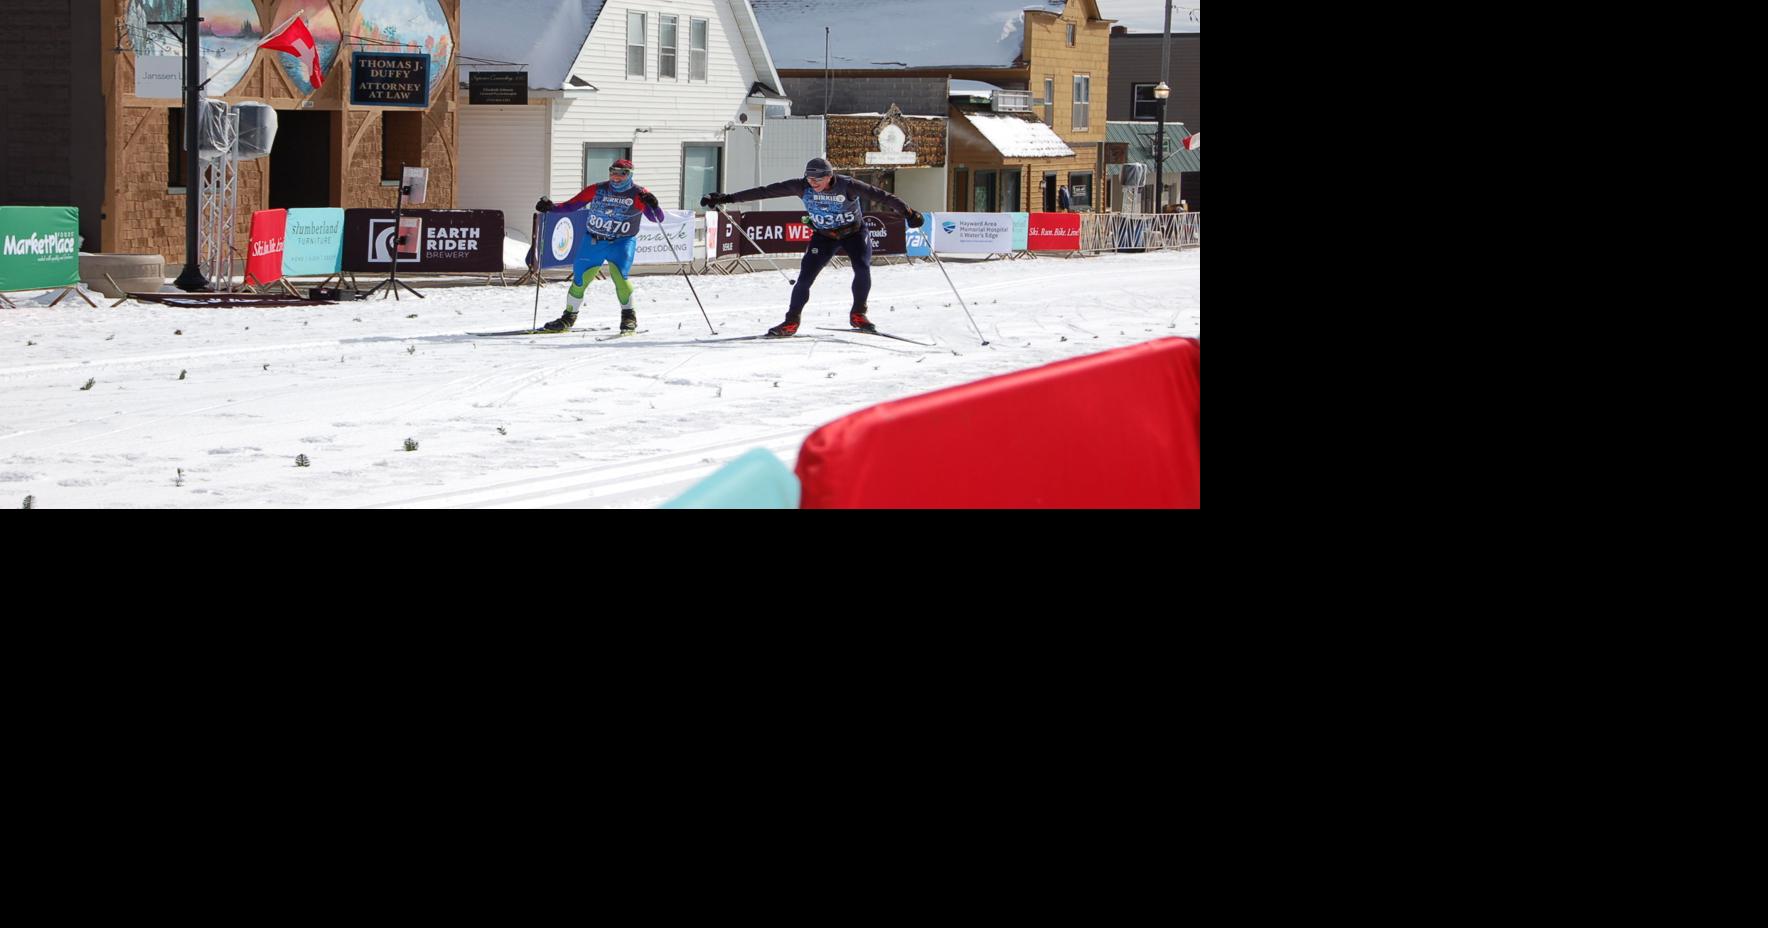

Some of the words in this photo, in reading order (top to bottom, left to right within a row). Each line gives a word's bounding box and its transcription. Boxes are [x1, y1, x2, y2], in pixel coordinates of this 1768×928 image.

[359, 60, 412, 69] THOMAS
[413, 61, 424, 71] J.
[143, 72, 177, 80] Janssen
[370, 69, 411, 78] DUFFY
[359, 82, 420, 91] ATTORNEY
[813, 194, 837, 202] BIRKIE
[291, 220, 339, 235] slumberland
[589, 214, 631, 233] 80470
[427, 228, 480, 238] EARTH
[638, 223, 688, 241] mark
[746, 225, 783, 240] GEAR
[869, 228, 888, 238] roads
[4, 232, 74, 255] MarketPlace
[297, 236, 332, 245] FURNITURE
[426, 239, 478, 250] RIDER
[870, 238, 880, 247] fee
[426, 251, 470, 259] BREWERY
